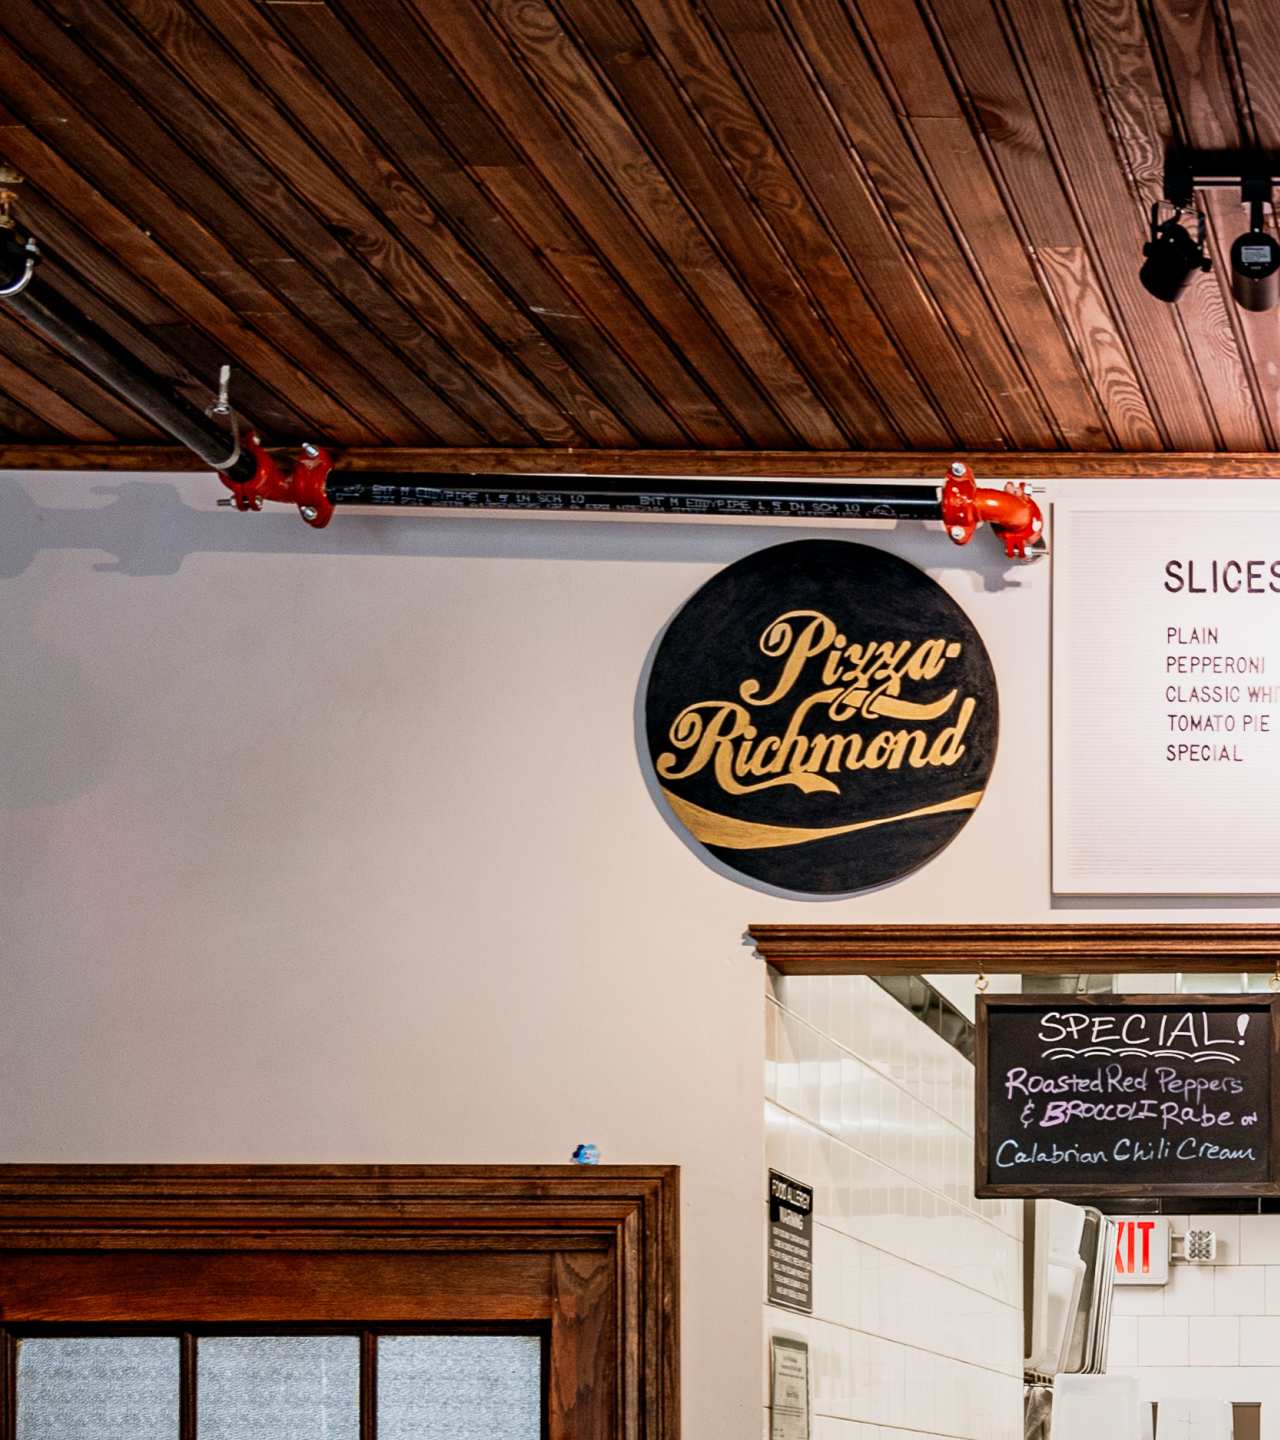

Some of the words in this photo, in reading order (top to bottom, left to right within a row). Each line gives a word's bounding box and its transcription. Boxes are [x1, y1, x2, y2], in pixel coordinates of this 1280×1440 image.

[1167, 627, 1218, 644] PLAIN
[740, 610, 961, 720] Pizza
[1167, 656, 1264, 673] PEPPERONI
[1166, 685, 1240, 702] CLASSIC
[1168, 714, 1235, 732] TOMATO
[1243, 715, 1270, 732] PIE
[657, 697, 976, 795] Richmond
[1166, 744, 1243, 761] SPECIAL
[1039, 1012, 1250, 1046] SPECIAL!
[1006, 1068, 1102, 1099] Roasted
[1106, 1064, 1148, 1092] Red
[1155, 1068, 1243, 1104] Peppers
[1162, 1103, 1234, 1129] Rabe
[996, 1140, 1108, 1167] Calabrian
[1113, 1138, 1172, 1161] Chili
[1176, 1138, 1255, 1161] Cream
[1115, 1221, 1154, 1273] XIT
